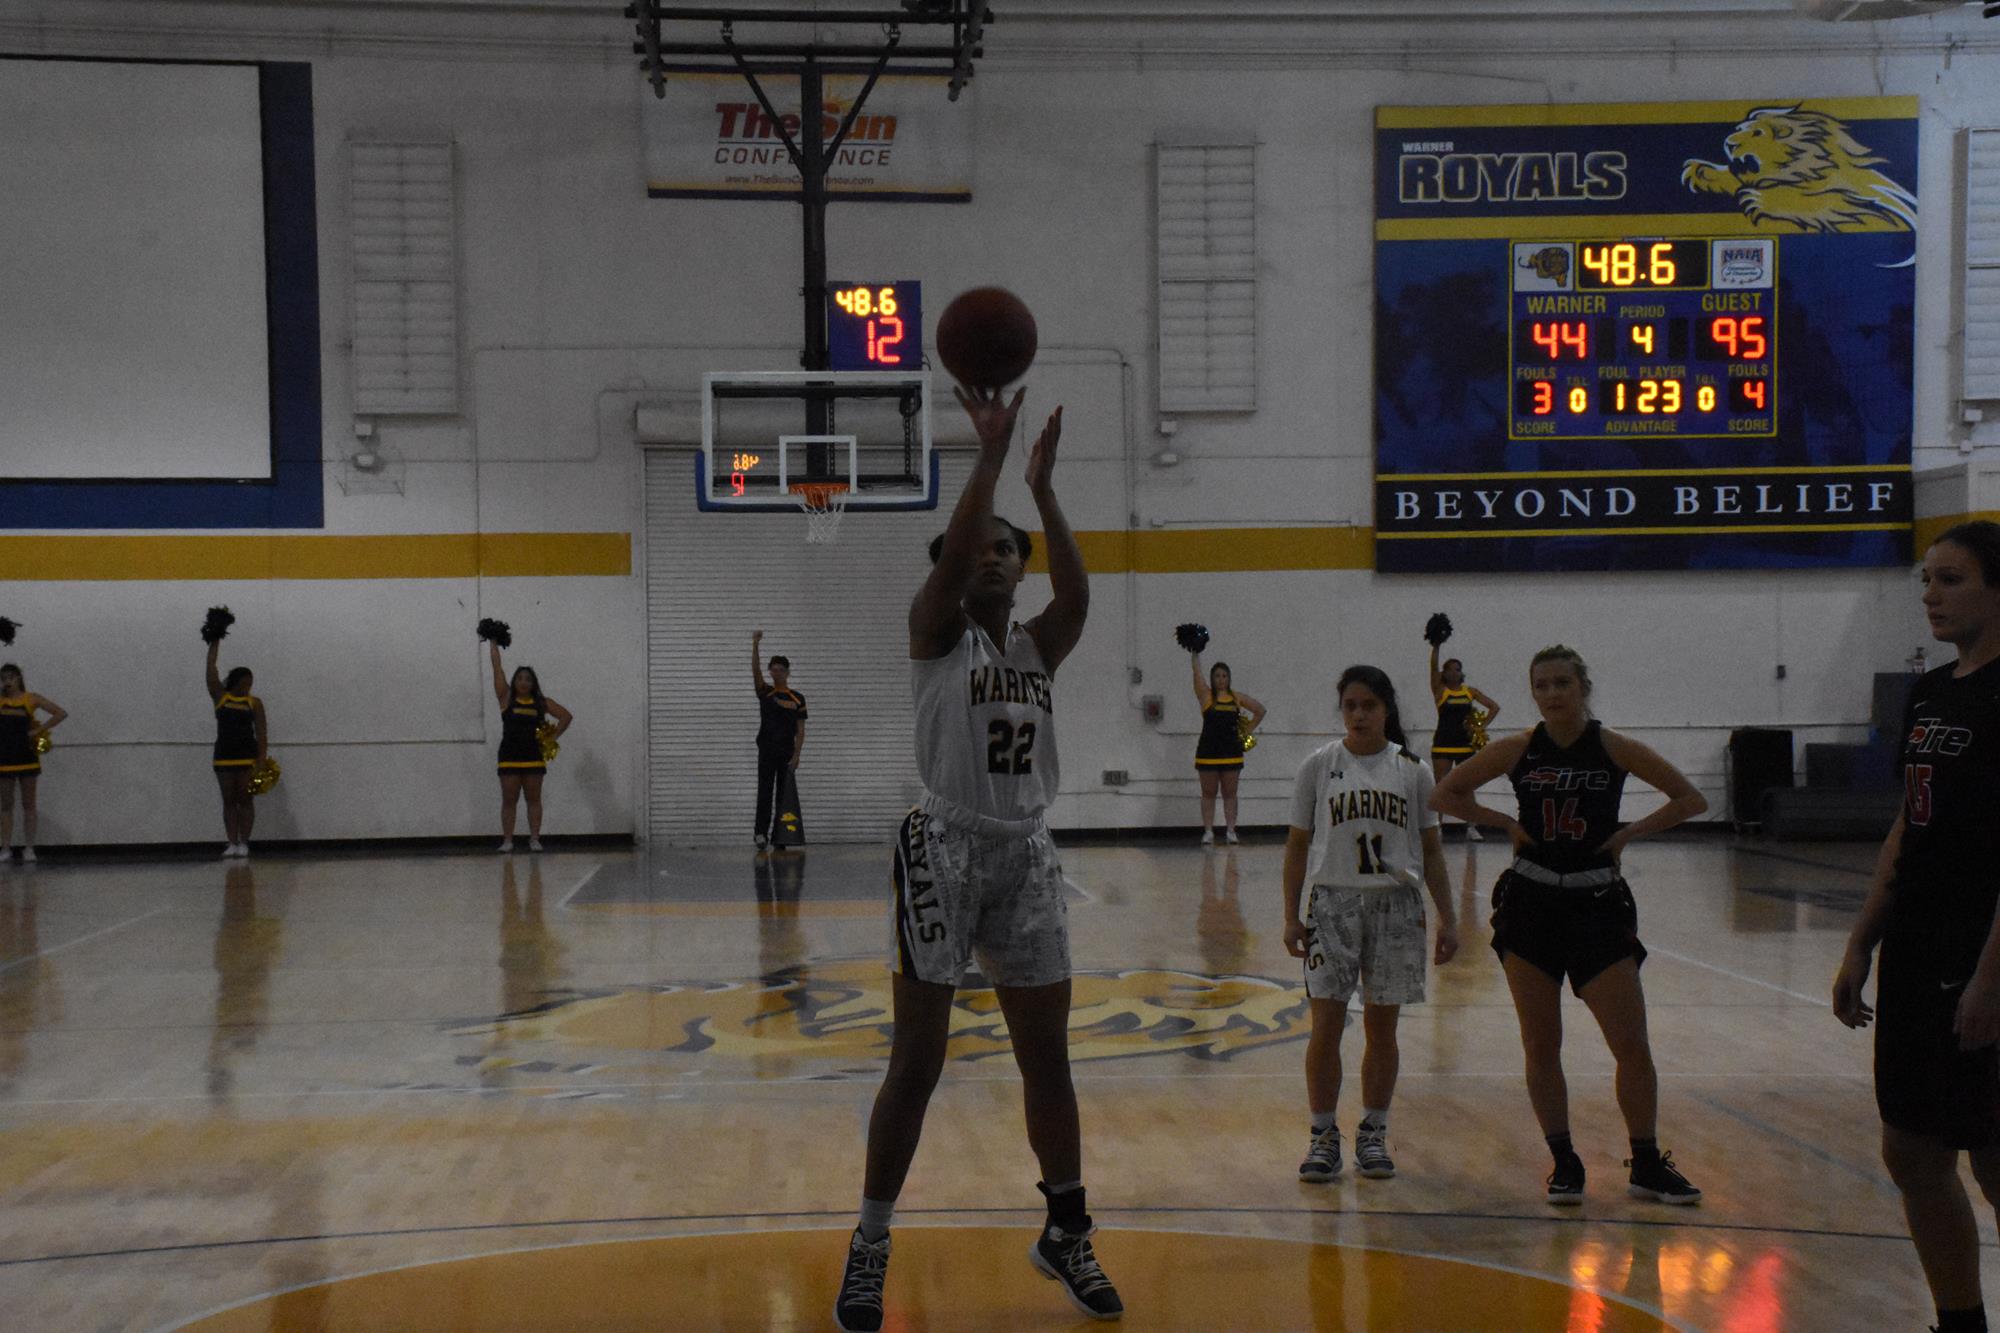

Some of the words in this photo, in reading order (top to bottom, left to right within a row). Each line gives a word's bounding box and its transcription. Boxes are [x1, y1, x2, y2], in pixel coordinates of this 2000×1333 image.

[715, 103, 800, 139] The
[822, 103, 897, 139] Sun
[1402, 141, 1454, 153] WARNER
[1400, 151, 1628, 202] ROYALS
[1583, 243, 1676, 286] 48.6
[1723, 248, 1762, 263] NAIA
[835, 287, 897, 317] 48.6
[1527, 295, 1607, 314] WARNER
[1620, 305, 1666, 319] PERIOD
[1702, 292, 1762, 312] GUEST
[867, 317, 903, 363] 12
[1533, 322, 1588, 360] 44
[1632, 325, 1654, 354] 4
[1711, 316, 1766, 359] 95
[1516, 366, 1557, 380] FOULS
[1598, 366, 1631, 379] FOUL
[1639, 365, 1687, 378] PLAYER
[1727, 363, 1769, 377] FOULS
[1533, 381, 1553, 414] 3
[1568, 387, 1588, 413] 0
[1696, 385, 1716, 412] 0
[1743, 380, 1765, 409] 4
[1516, 421, 1557, 434] SCORE
[1605, 420, 1678, 434] ADVANTAGE
[1727, 418, 1769, 432] SCORE
[1394, 486, 1638, 520] BEYOND
[1673, 481, 1895, 516] BELIEF
[987, 718, 1036, 776] 22
[1519, 766, 1611, 792] Fire
[1328, 789, 1409, 829] WARNER
[1904, 763, 1933, 827] 15
[1542, 797, 1588, 842] 14
[1357, 832, 1387, 874] 11
